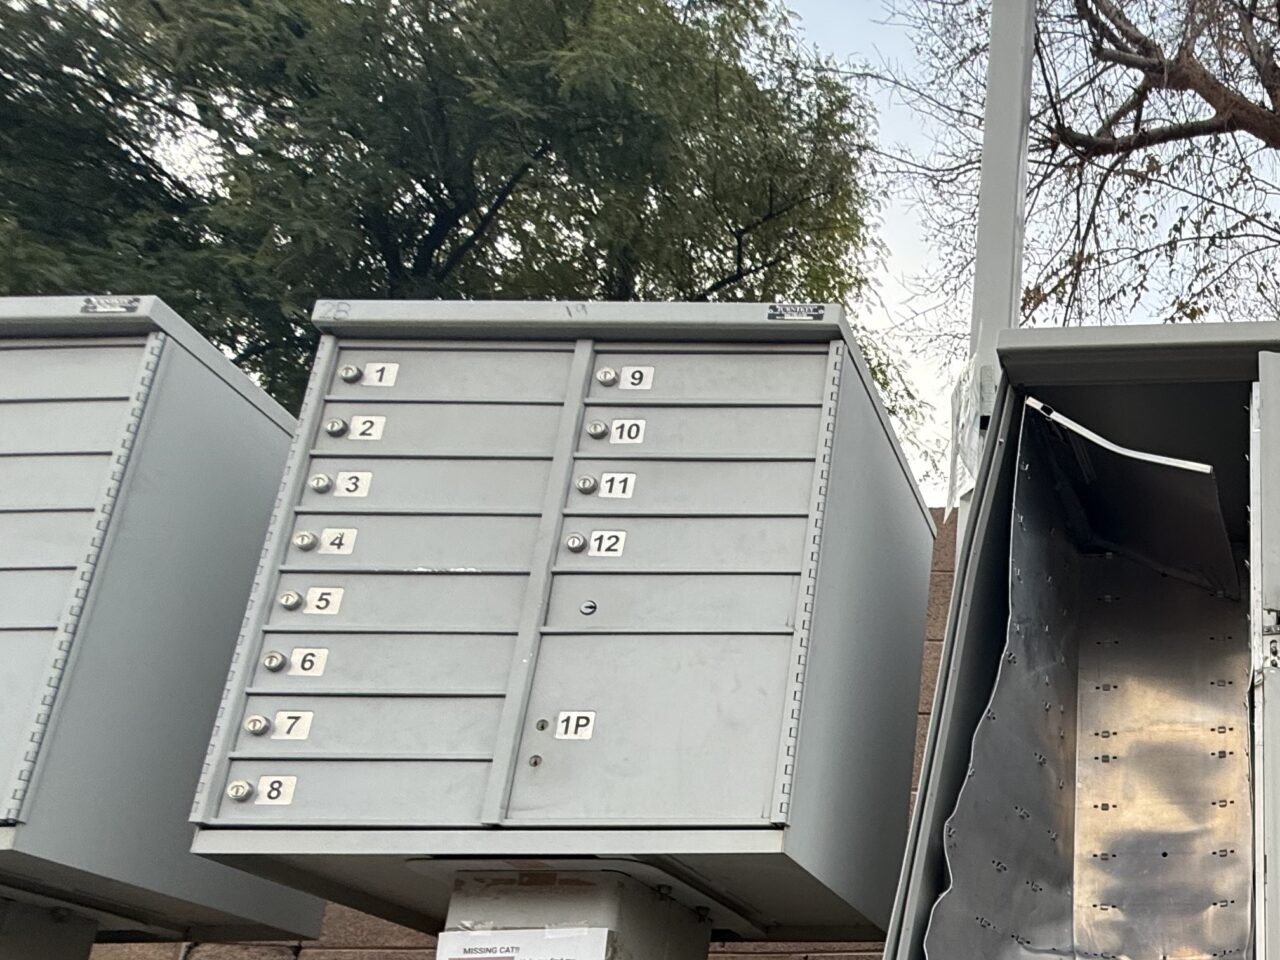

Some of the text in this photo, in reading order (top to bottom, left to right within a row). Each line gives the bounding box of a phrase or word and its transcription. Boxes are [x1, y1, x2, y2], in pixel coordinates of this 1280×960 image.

[375, 366, 386, 383] 1
[630, 369, 644, 387] 9
[358, 419, 375, 437] 2
[615, 423, 641, 440] 10
[345, 475, 360, 493] 3
[605, 476, 629, 494] 11
[329, 532, 345, 550] 4
[593, 534, 620, 553] 12
[315, 592, 332, 611] 5
[300, 652, 316, 672] 6
[285, 715, 302, 735] 7
[561, 715, 591, 735] 1P
[266, 780, 283, 801] 8
